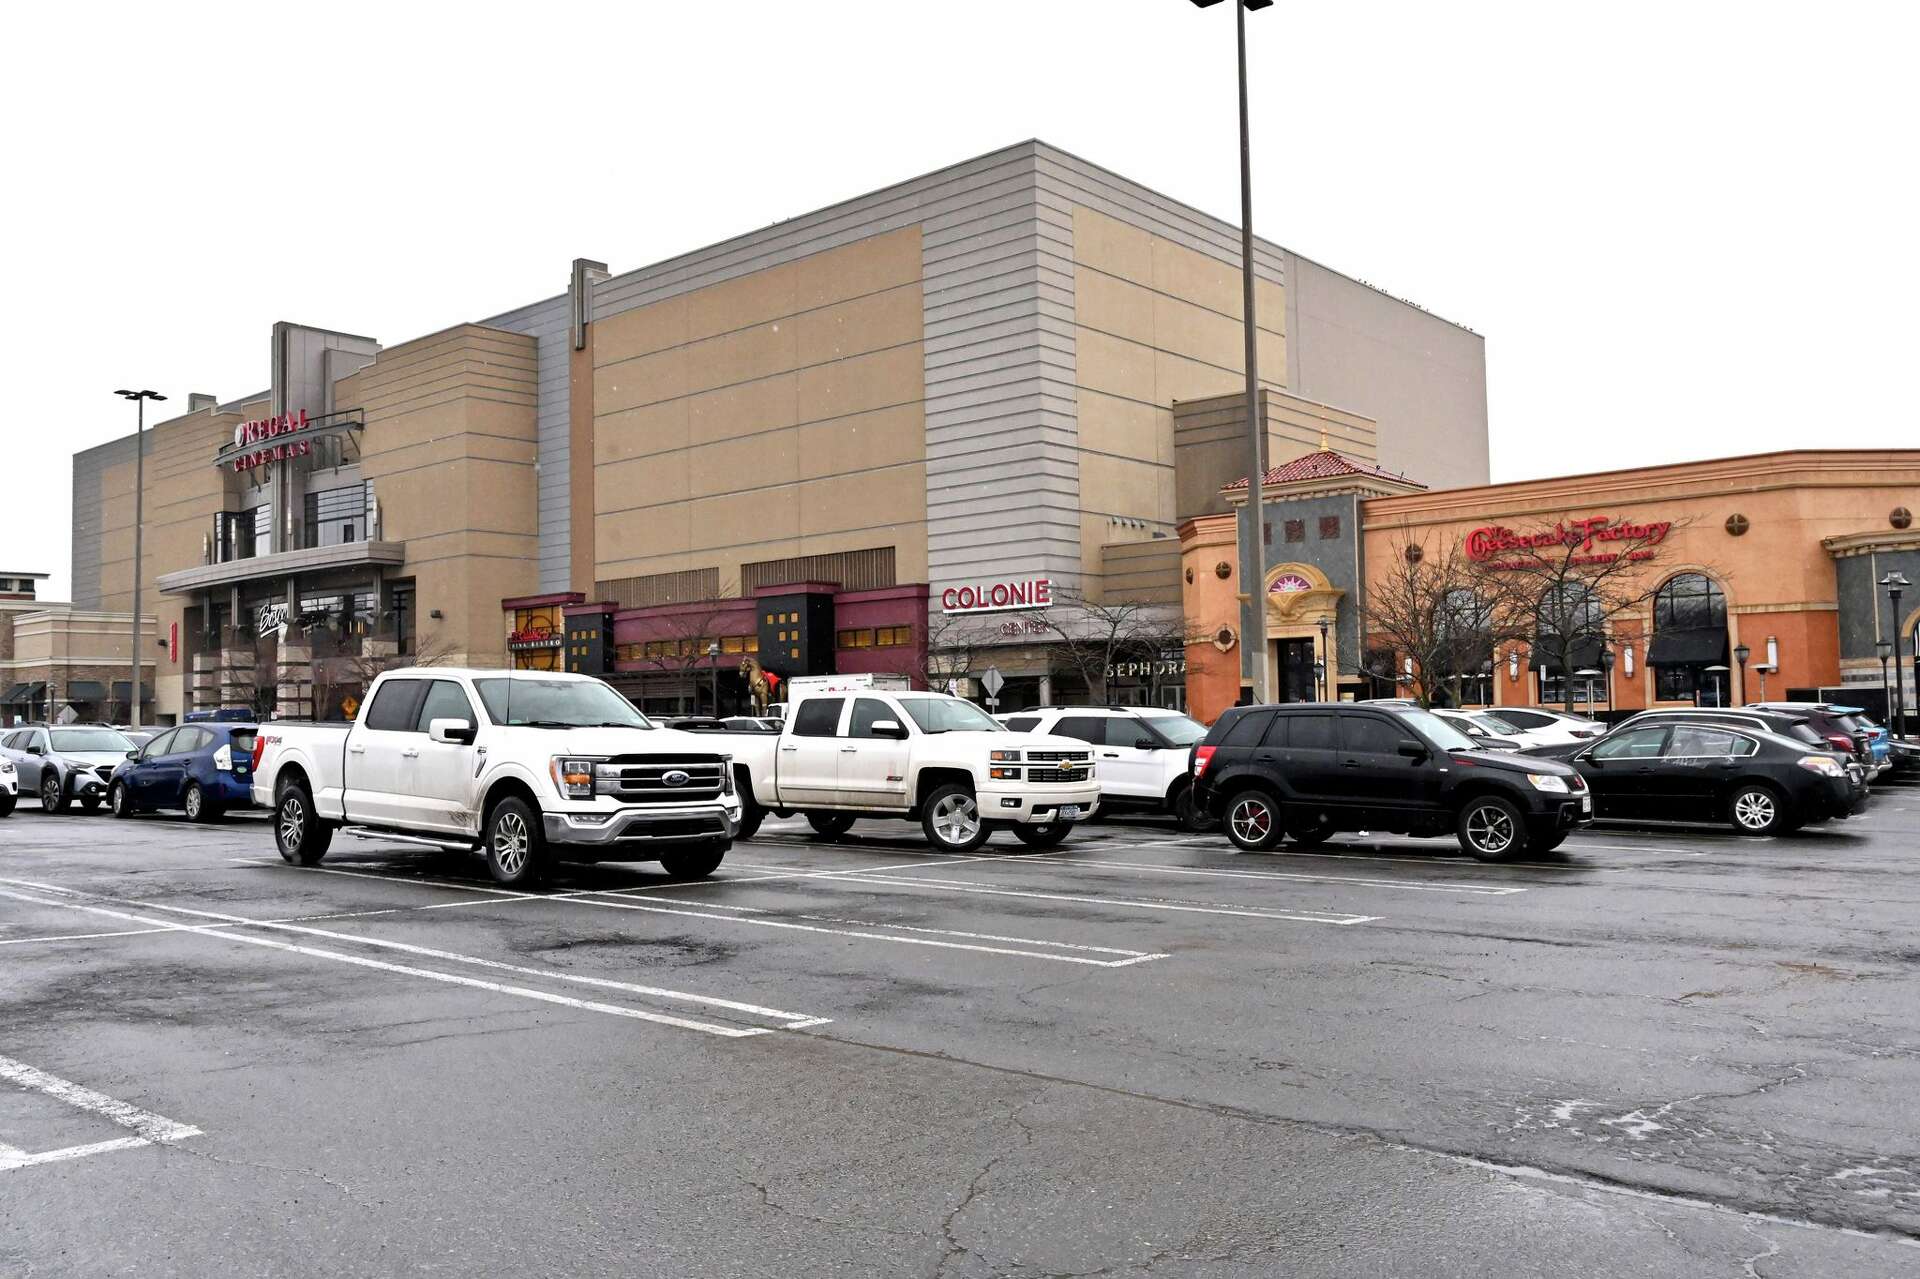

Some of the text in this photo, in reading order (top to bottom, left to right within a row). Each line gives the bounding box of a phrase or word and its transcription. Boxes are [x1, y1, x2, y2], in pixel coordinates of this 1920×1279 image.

[234, 440, 311, 472] CINEMAS
[1571, 515, 1671, 552] Factory
[942, 579, 1051, 610] COLONIE
[1000, 620, 1050, 637] CENTER
